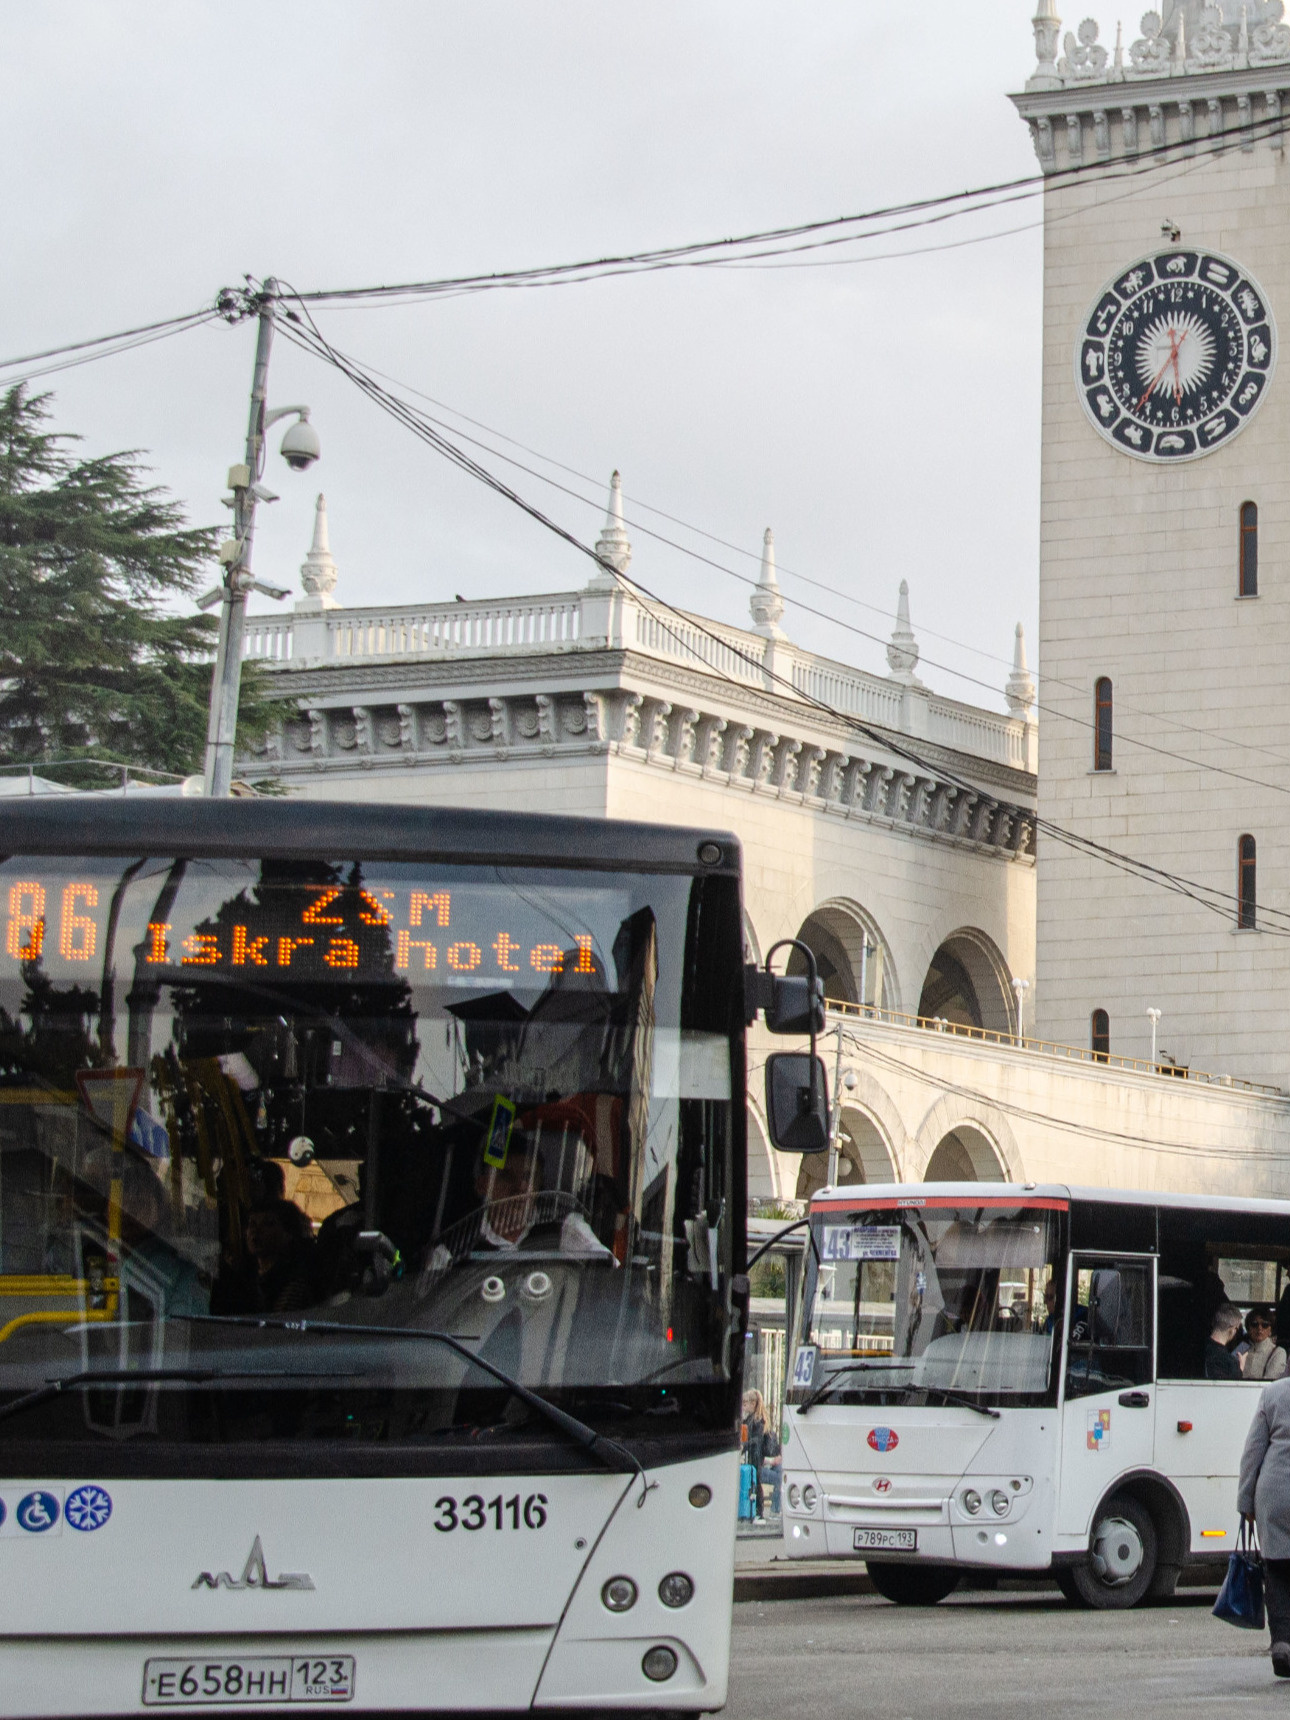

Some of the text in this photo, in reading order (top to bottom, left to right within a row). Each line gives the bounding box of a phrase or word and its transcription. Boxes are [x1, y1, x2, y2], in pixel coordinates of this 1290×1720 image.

[1171, 288, 1183, 303] 12
[1143, 299, 1154, 314] 11
[1221, 313, 1229, 327] 2
[1122, 321, 1134, 336] 10
[1229, 342, 1237, 357] 3
[1200, 396, 1207, 411] 5
[1171, 406, 1179, 421] 6
[6, 882, 98, 960] 86
[146, 922, 596, 973] Iskra hotel
[827, 1228, 850, 1259] 43
[795, 1352, 814, 1382] 43
[433, 1493, 548, 1532] 33116
[897, 1532, 912, 1543] 193
[297, 1661, 344, 1685] 123
[305, 1685, 329, 1695] RUS
